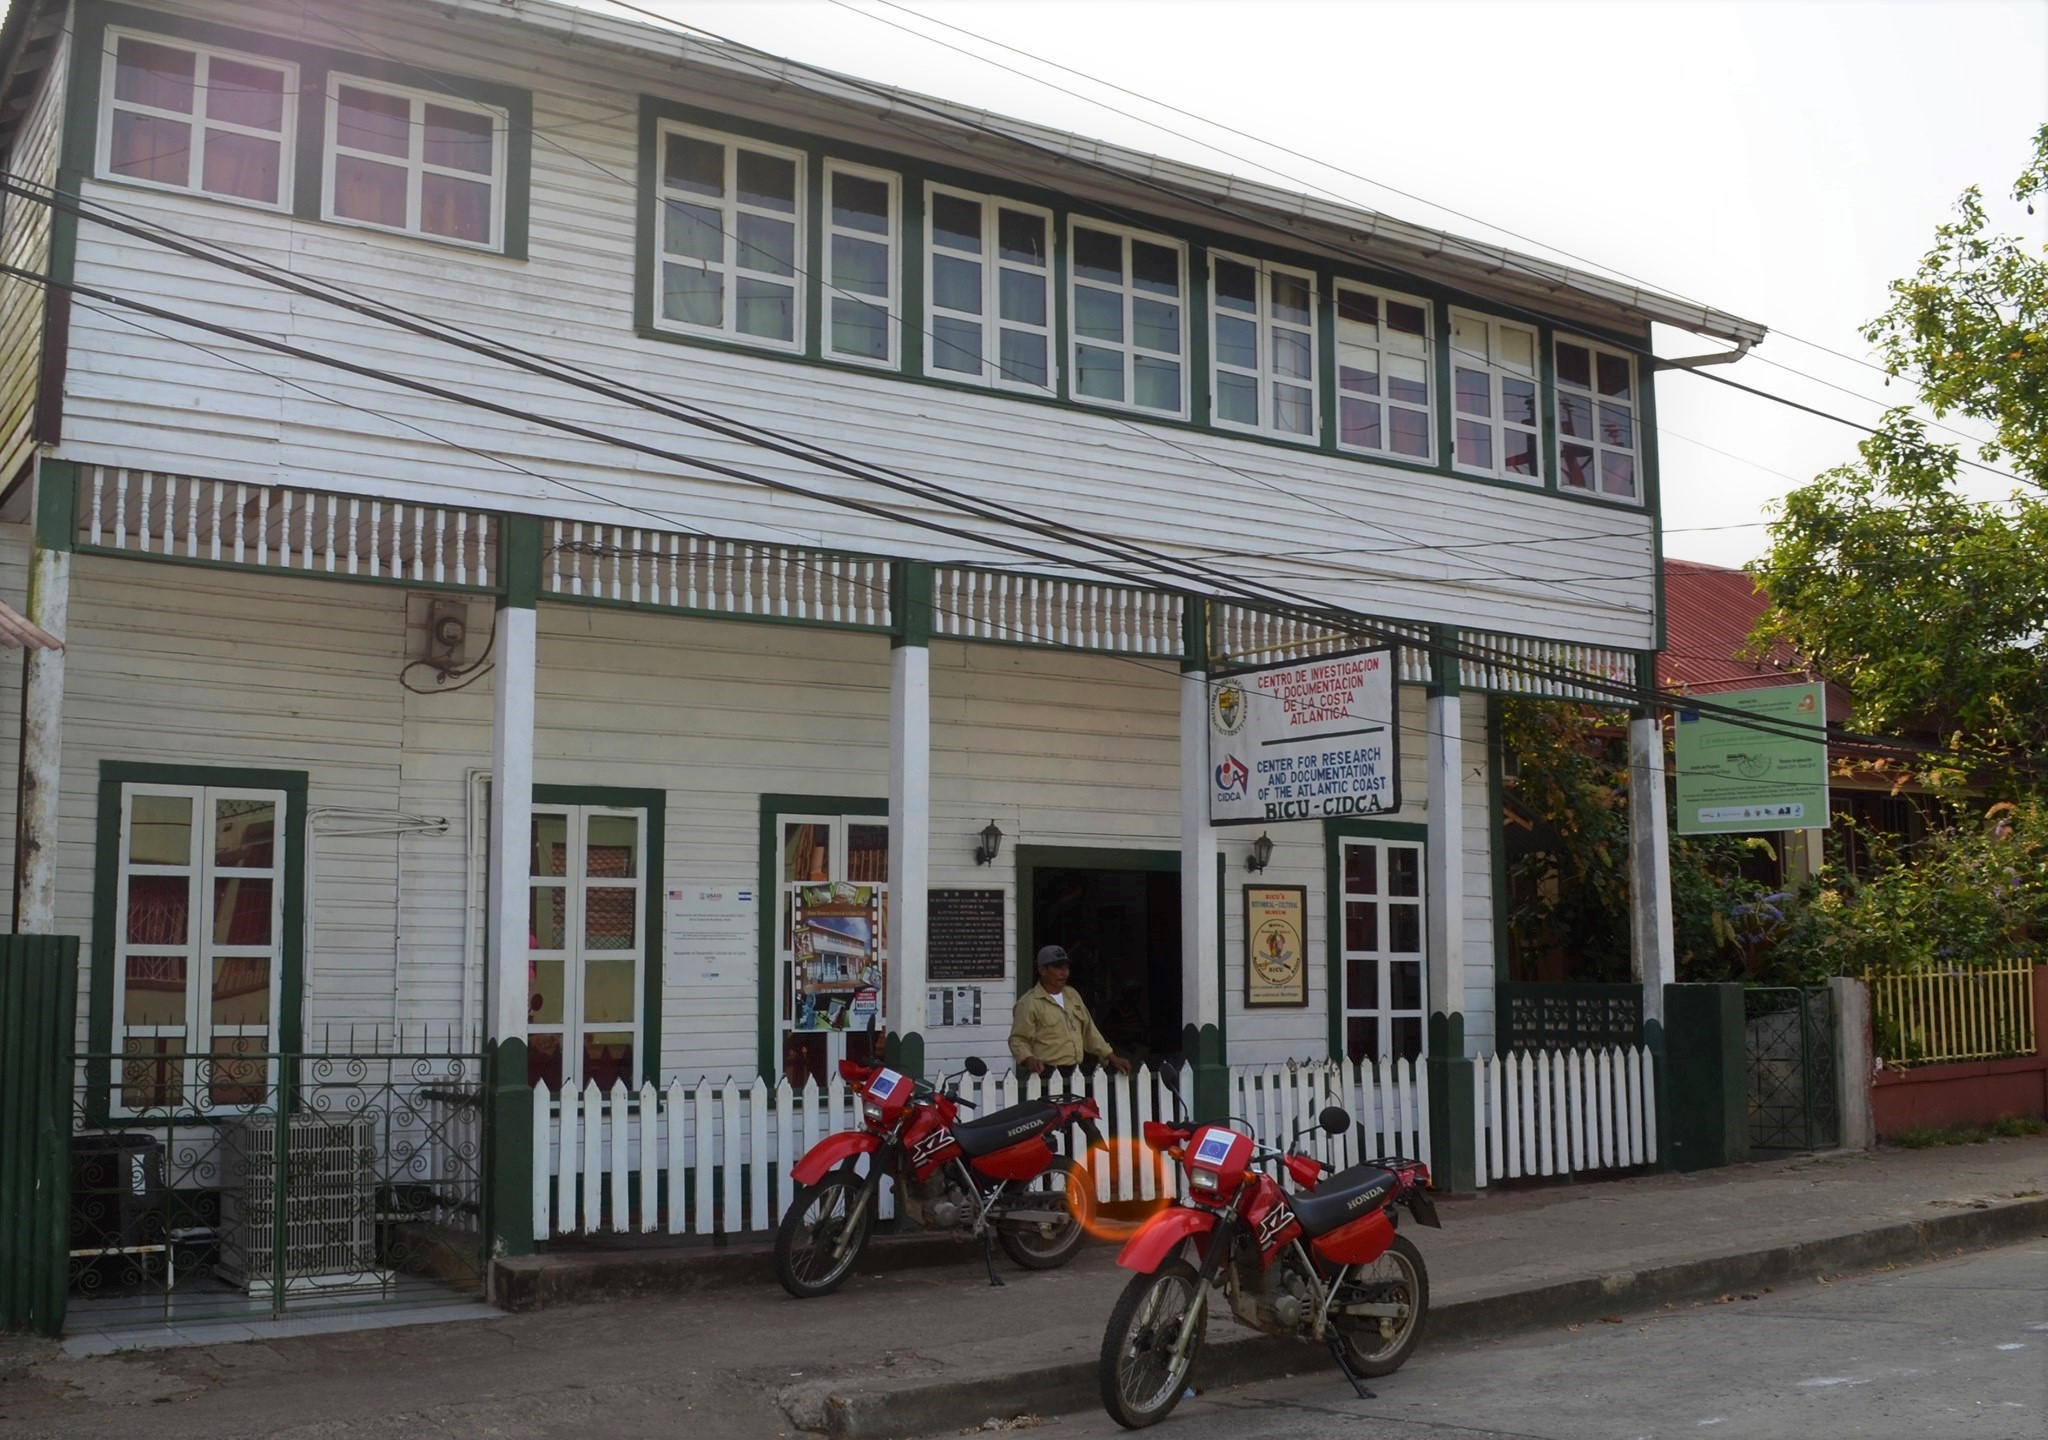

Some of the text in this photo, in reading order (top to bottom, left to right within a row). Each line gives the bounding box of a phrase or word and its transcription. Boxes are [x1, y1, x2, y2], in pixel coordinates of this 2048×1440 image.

[1258, 658, 1379, 688] CENTRO DE INVESTIGACION
[1273, 675, 1364, 699] Y DOCUMENTACION
[1283, 691, 1354, 712] DE LA COSTA
[1290, 706, 1349, 725] ATLANTICA
[1257, 747, 1381, 773] CENTER FOR RESEARCH
[1268, 763, 1375, 785] AND DOCUMENTATION
[1217, 792, 1241, 802] CIDCA
[1258, 776, 1386, 800] OF THE ATLANTIC COAST
[1008, 1119, 1044, 1136] HONDA
[1347, 1186, 1384, 1209] HONDA
